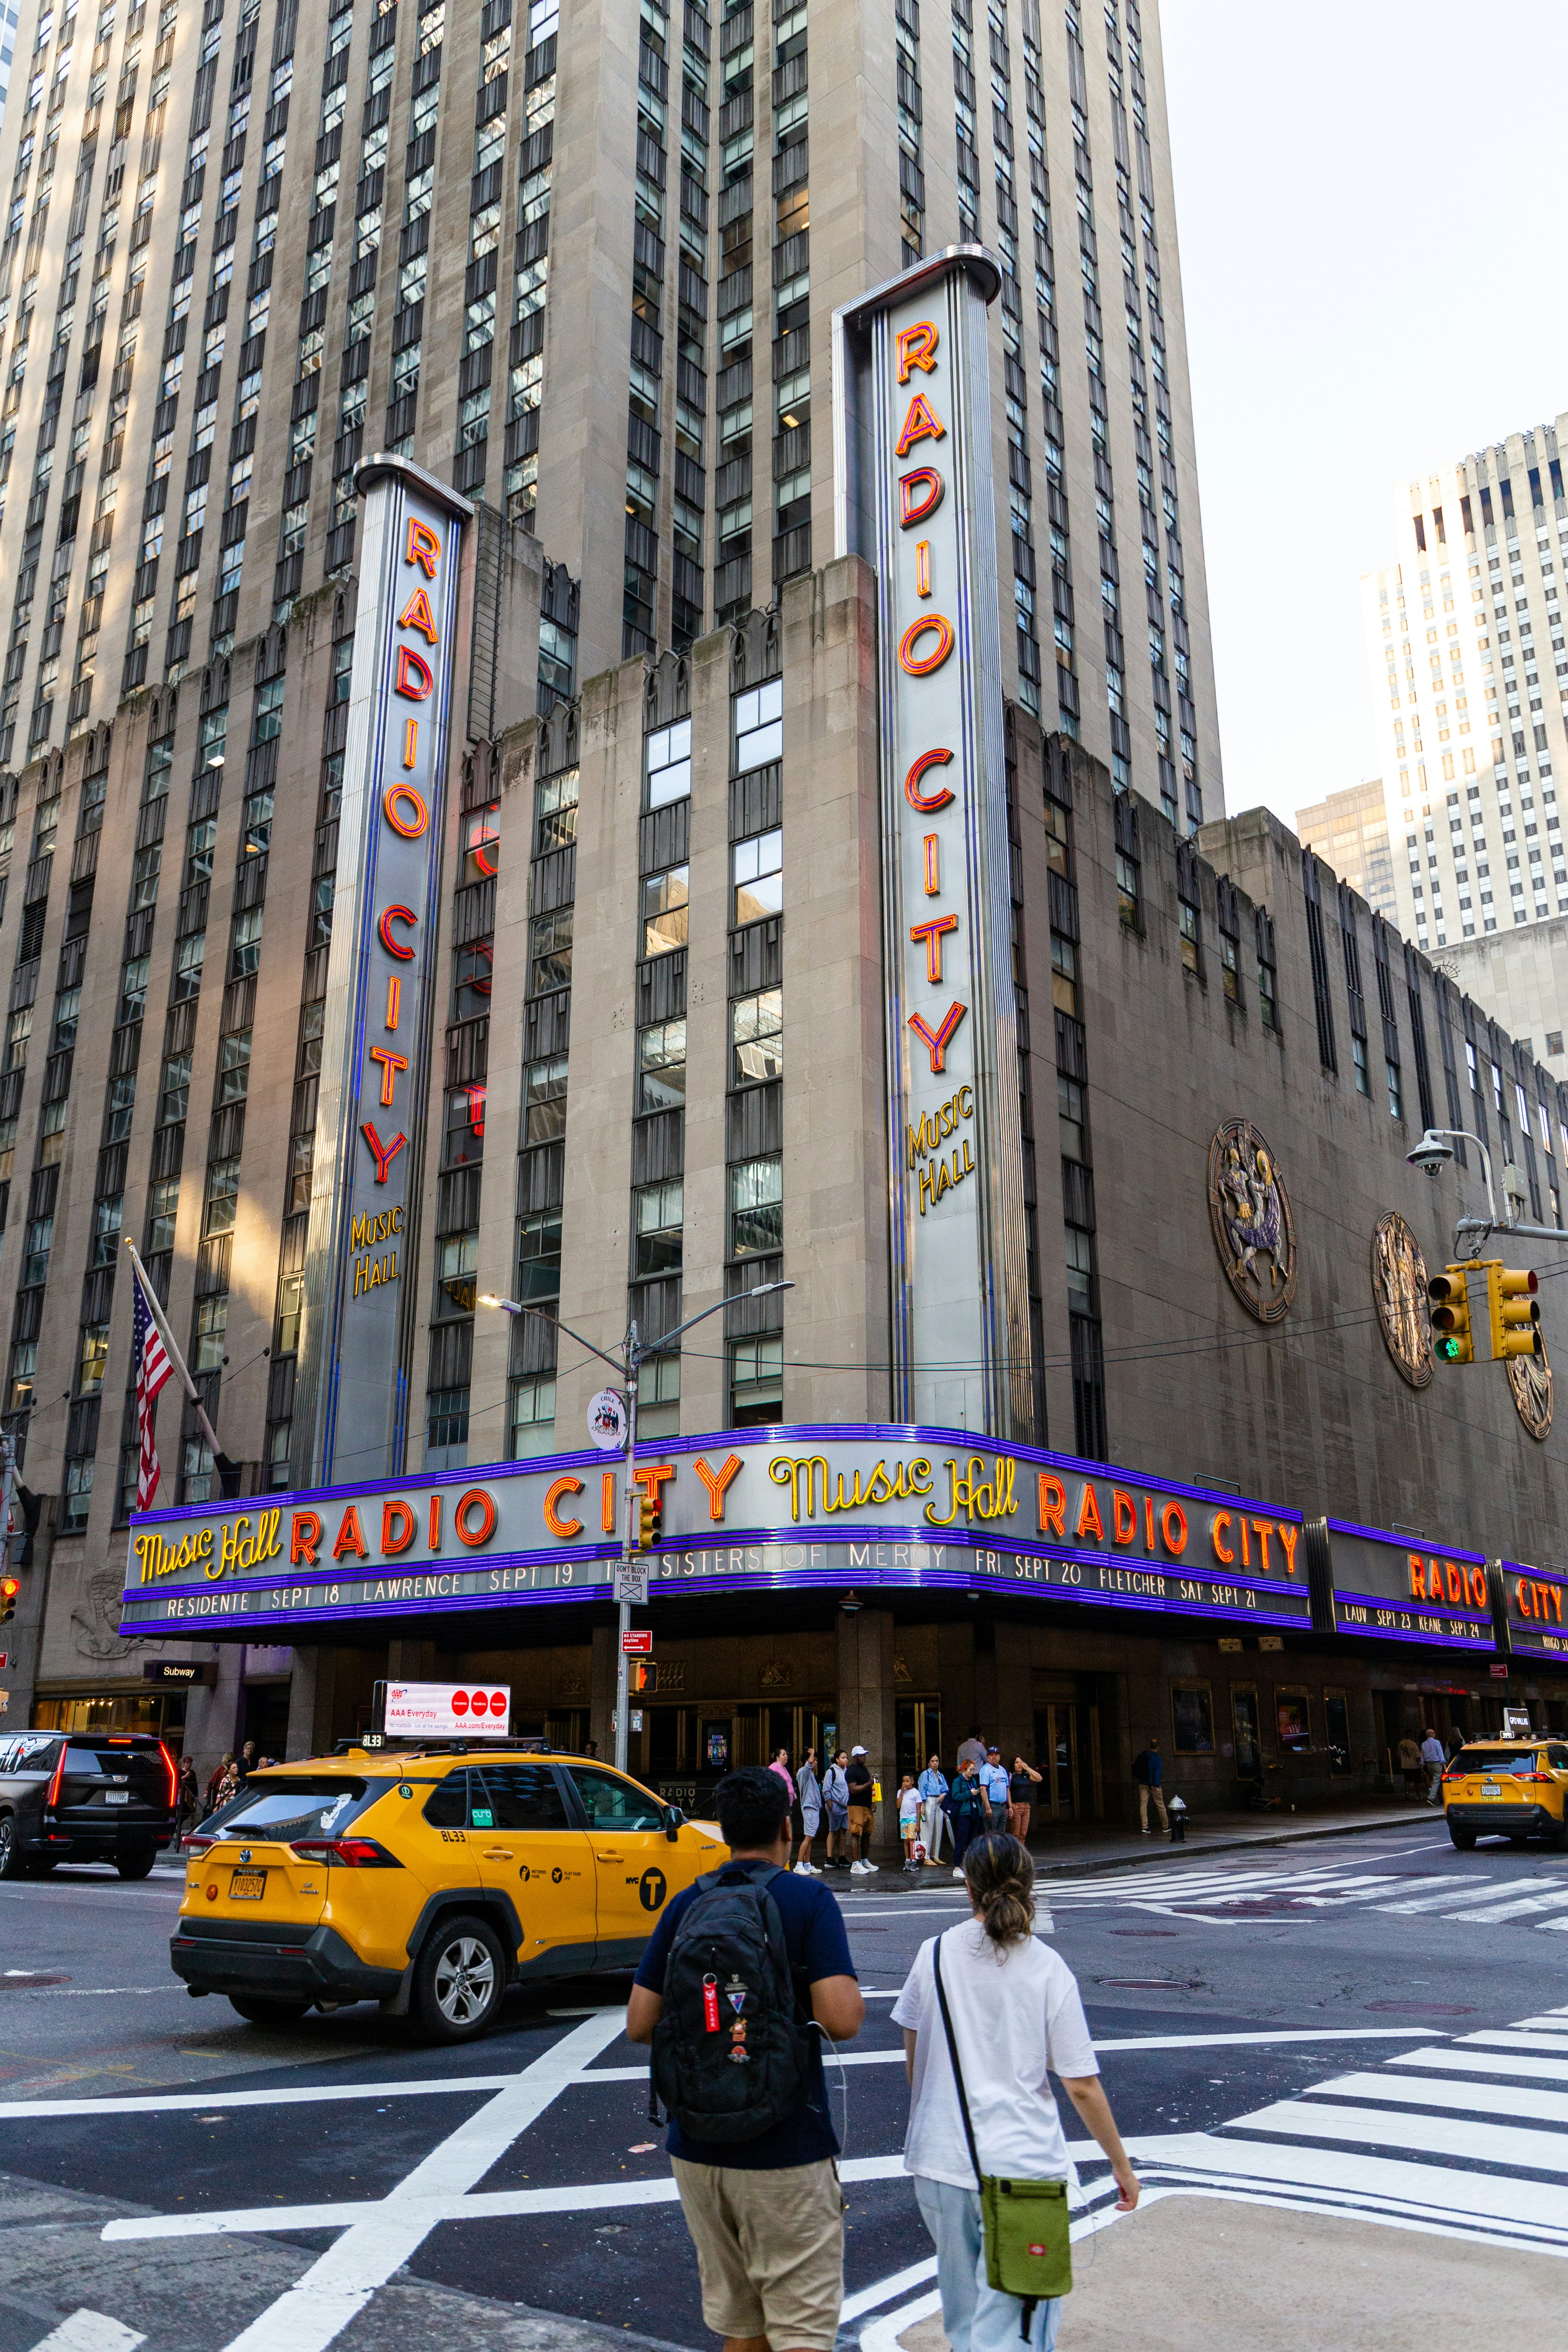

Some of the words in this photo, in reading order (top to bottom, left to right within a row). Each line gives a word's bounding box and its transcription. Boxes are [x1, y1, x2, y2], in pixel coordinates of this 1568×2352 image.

[895, 322, 955, 676] RADIO
[383, 517, 441, 838] RADIO
[905, 748, 967, 1074] CITY
[360, 904, 418, 1184] CITY
[769, 1456, 934, 1522] Music
[923, 1455, 1020, 1526] Hall
[290, 1488, 498, 1565] RADIO
[544, 1454, 744, 1537] CITY
[1036, 1472, 1188, 1555] RADIO
[1211, 1510, 1298, 1574] CITY
[135, 1528, 212, 1583] Music
[205, 1506, 283, 1580] Hall
[167, 1592, 248, 1617] RESIDENTE
[271, 1587, 313, 1608] SEPT
[324, 1584, 340, 1604] 18
[363, 1574, 461, 1601] LAWRENCE
[490, 1566, 539, 1590] SEPT
[554, 1563, 573, 1585] 19
[661, 1548, 760, 1577] SISTERS
[784, 1544, 823, 1567] OF
[849, 1543, 944, 1567] MERCY
[976, 1550, 1004, 1575] FRI.
[1015, 1556, 1051, 1580] SEPT
[1062, 1562, 1081, 1584] 20
[1099, 1568, 1165, 1596] FLETCHER
[1212, 1584, 1238, 1605] SEPT
[1246, 1590, 1256, 1608] 21
[631, 1566, 646, 1574] BLOCK
[1409, 1554, 1487, 1607] RADIO
[1517, 1578, 1562, 1622] CITY
[1345, 1605, 1367, 1623] LAUV
[1377, 1610, 1396, 1628] SEPT
[1401, 1613, 1411, 1629] 23
[1419, 1616, 1443, 1633] KEANE
[1450, 1620, 1467, 1636] SEPT
[1470, 1623, 1479, 1638] 24
[1543, 1635, 1560, 1650] RINGO
[164, 1666, 195, 1678] Subway
[407, 1709, 437, 1719] Everyday
[455, 1722, 505, 1730] AAA.com/Everyday
[362, 1734, 382, 1747] 8L33
[660, 1788, 695, 1797] RADIO
[472, 1809, 491, 1818] curb
[441, 1830, 466, 1842] 8L33
[646, 1876, 661, 1905] T
